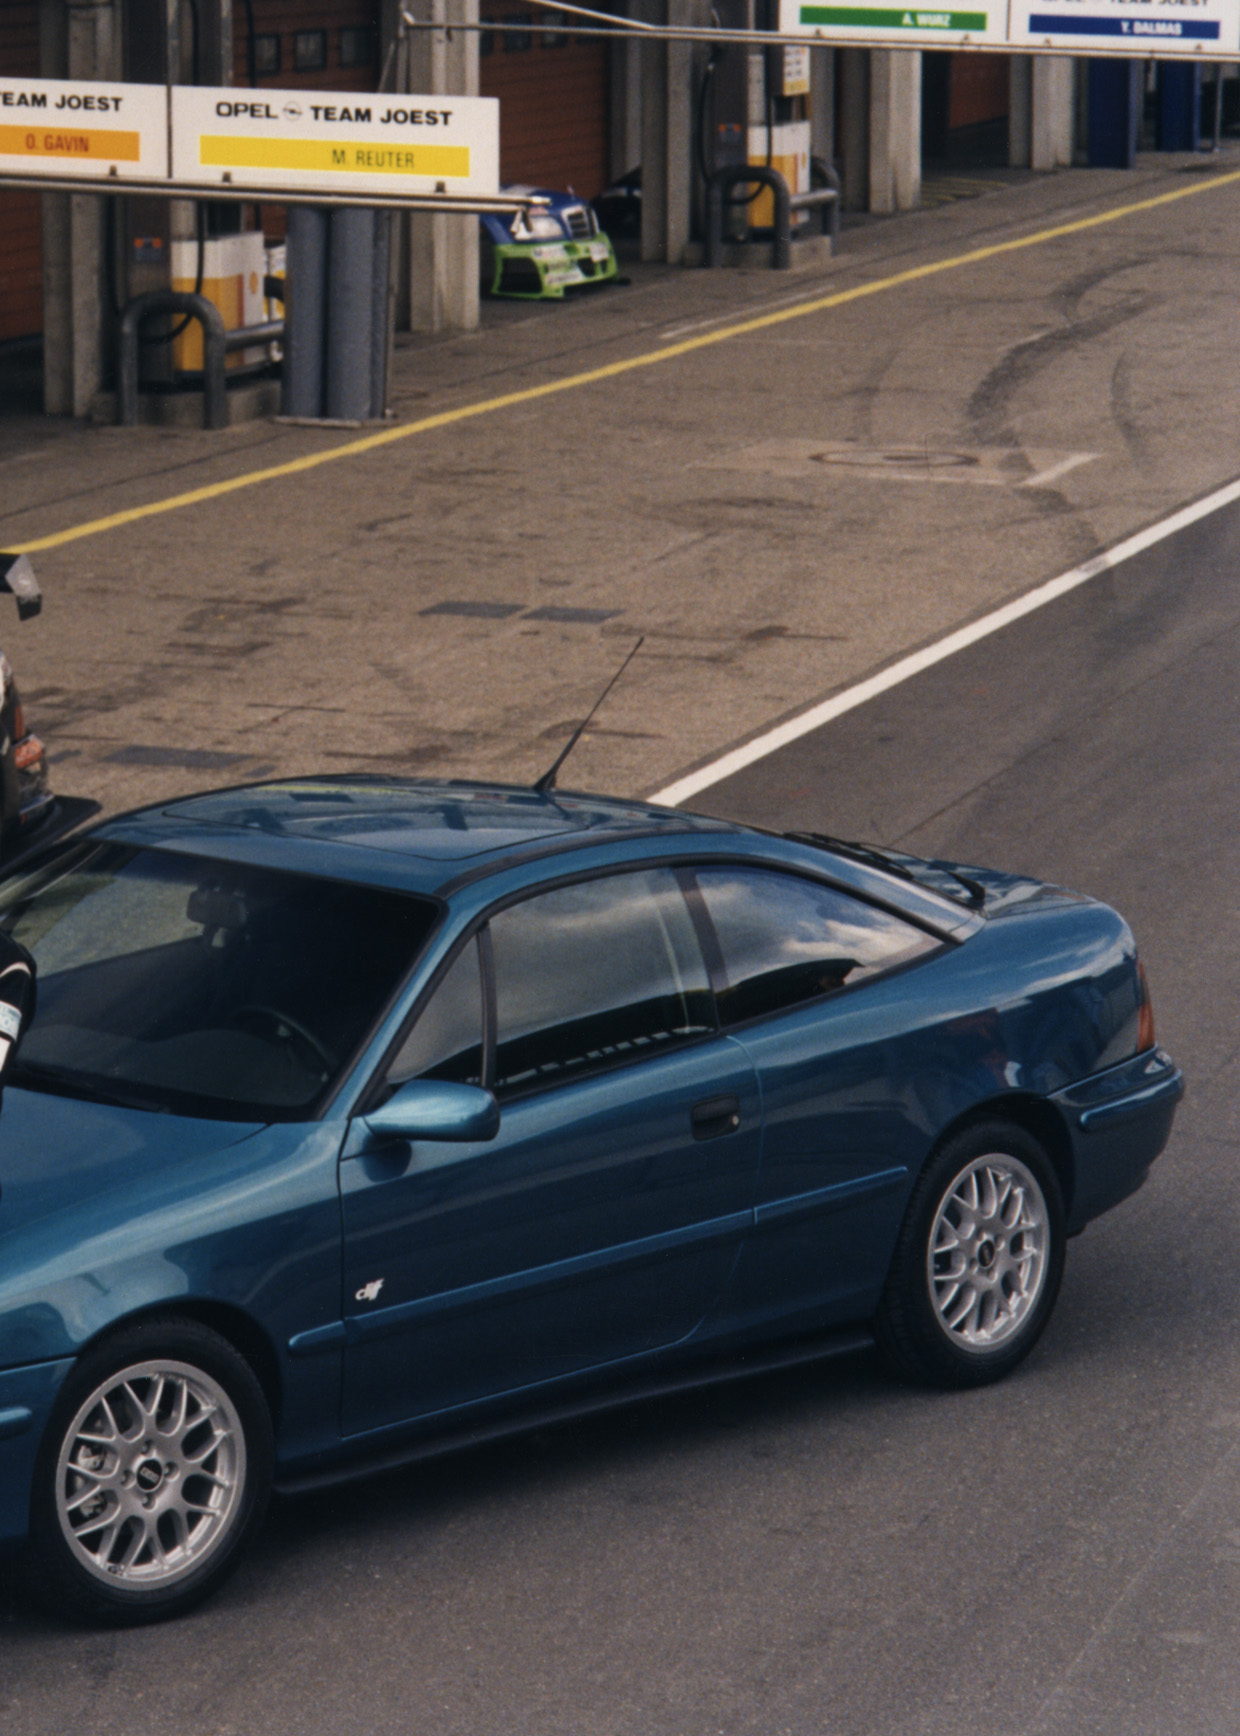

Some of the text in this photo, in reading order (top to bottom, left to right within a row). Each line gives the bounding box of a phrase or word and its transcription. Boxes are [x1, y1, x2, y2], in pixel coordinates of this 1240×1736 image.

[55, 94, 123, 112] JOEST
[216, 102, 453, 126] OPEL TEAM JOEST
[44, 134, 90, 152] GAVIN
[356, 150, 415, 168] REUTER
